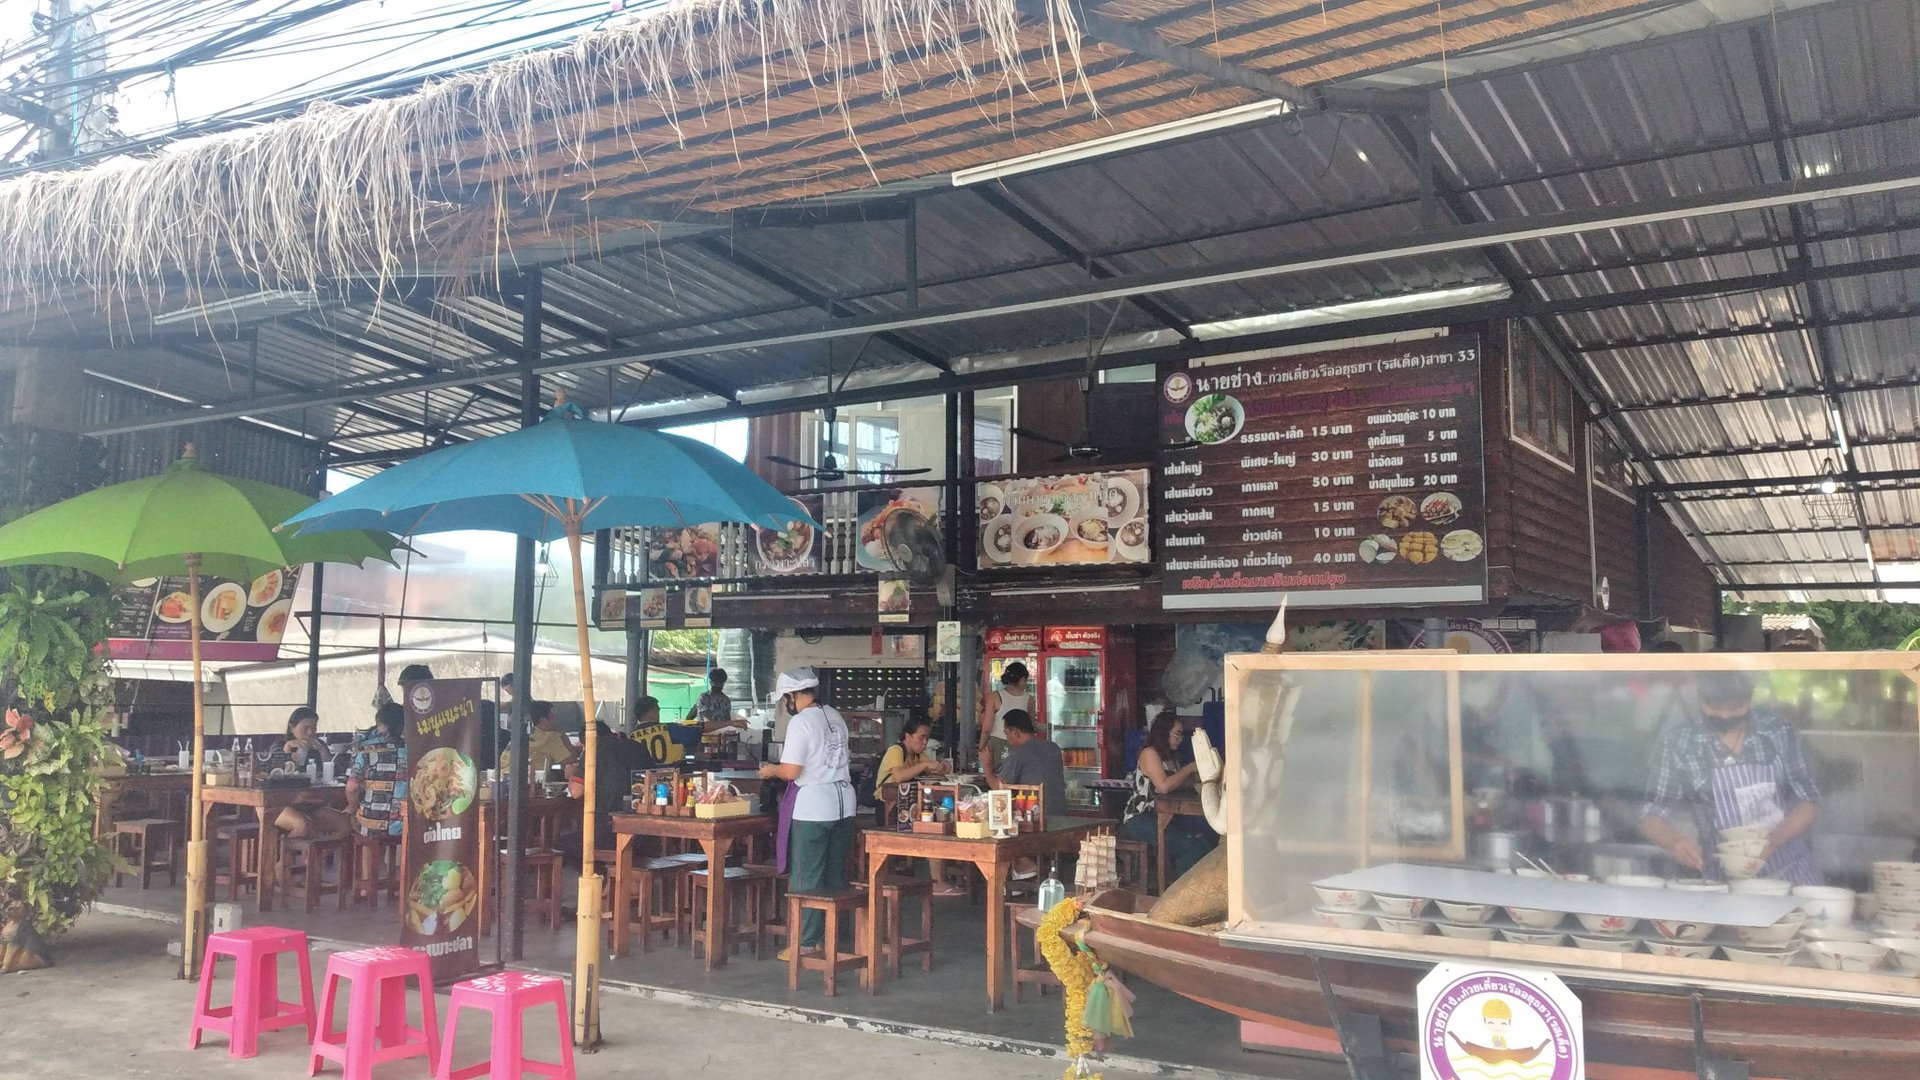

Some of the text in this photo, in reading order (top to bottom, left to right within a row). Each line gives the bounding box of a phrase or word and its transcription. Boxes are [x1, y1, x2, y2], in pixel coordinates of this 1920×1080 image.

[1457, 349, 1476, 362] 33
[1422, 409, 1436, 420] 10
[1438, 406, 1456, 419] บาท
[1240, 424, 1353, 444] ธรรมดา-เล็ก 15 บาท
[1367, 429, 1457, 449] ลูกชิ้นหมู 5 บาท
[1241, 449, 1353, 469] พิเศษ-ใหญ่ 30 บาท
[1368, 451, 1457, 468] น้ำอัดลม 15 บาท
[1164, 461, 1202, 476] เส้นใหญ่
[1241, 475, 1354, 494] เกาเหลา 50 บาท
[1368, 473, 1458, 491] น้ำสมุนไพร 20 บาท
[1164, 483, 1213, 500] เส้นหมี่ขาว
[1165, 508, 1213, 525] เส้นวุ้นเส้น
[1242, 499, 1355, 519] กากหมู 15 บาท
[1165, 534, 1205, 547] เส้นมาม่า
[1242, 525, 1355, 542] ข้าวเปล่า 10 บาท
[1165, 554, 1239, 571] เส้นบะหมี่เหลือง
[1313, 552, 1330, 564] 40
[1334, 551, 1356, 563] บาท
